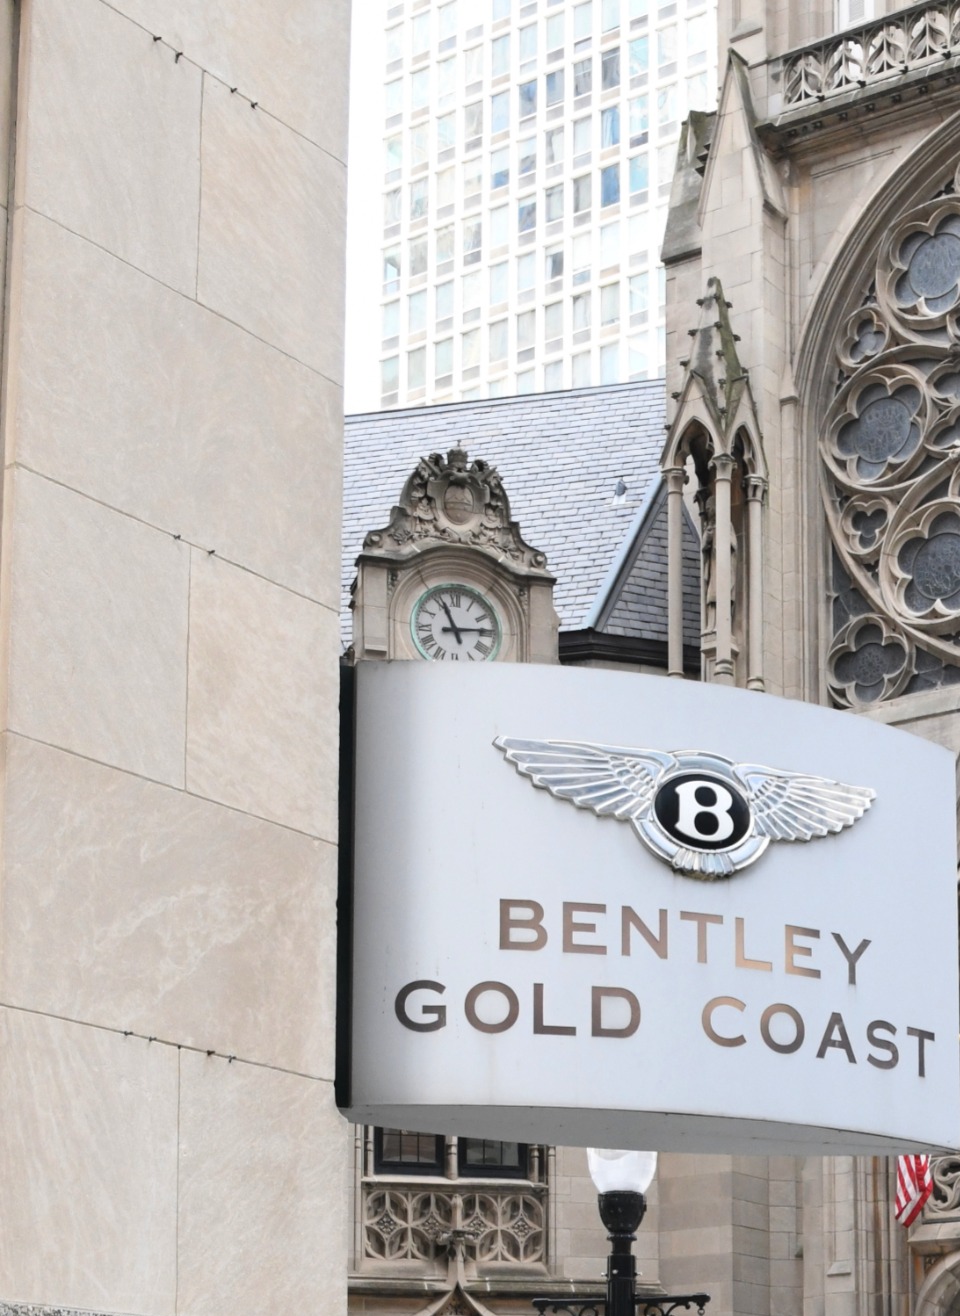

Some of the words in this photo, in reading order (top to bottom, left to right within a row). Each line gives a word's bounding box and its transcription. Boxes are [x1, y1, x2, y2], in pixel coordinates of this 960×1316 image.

[675, 780, 735, 842] B
[499, 898, 872, 986] BENTLEY
[394, 980, 641, 1038] GOLD
[701, 995, 936, 1078] COAST
